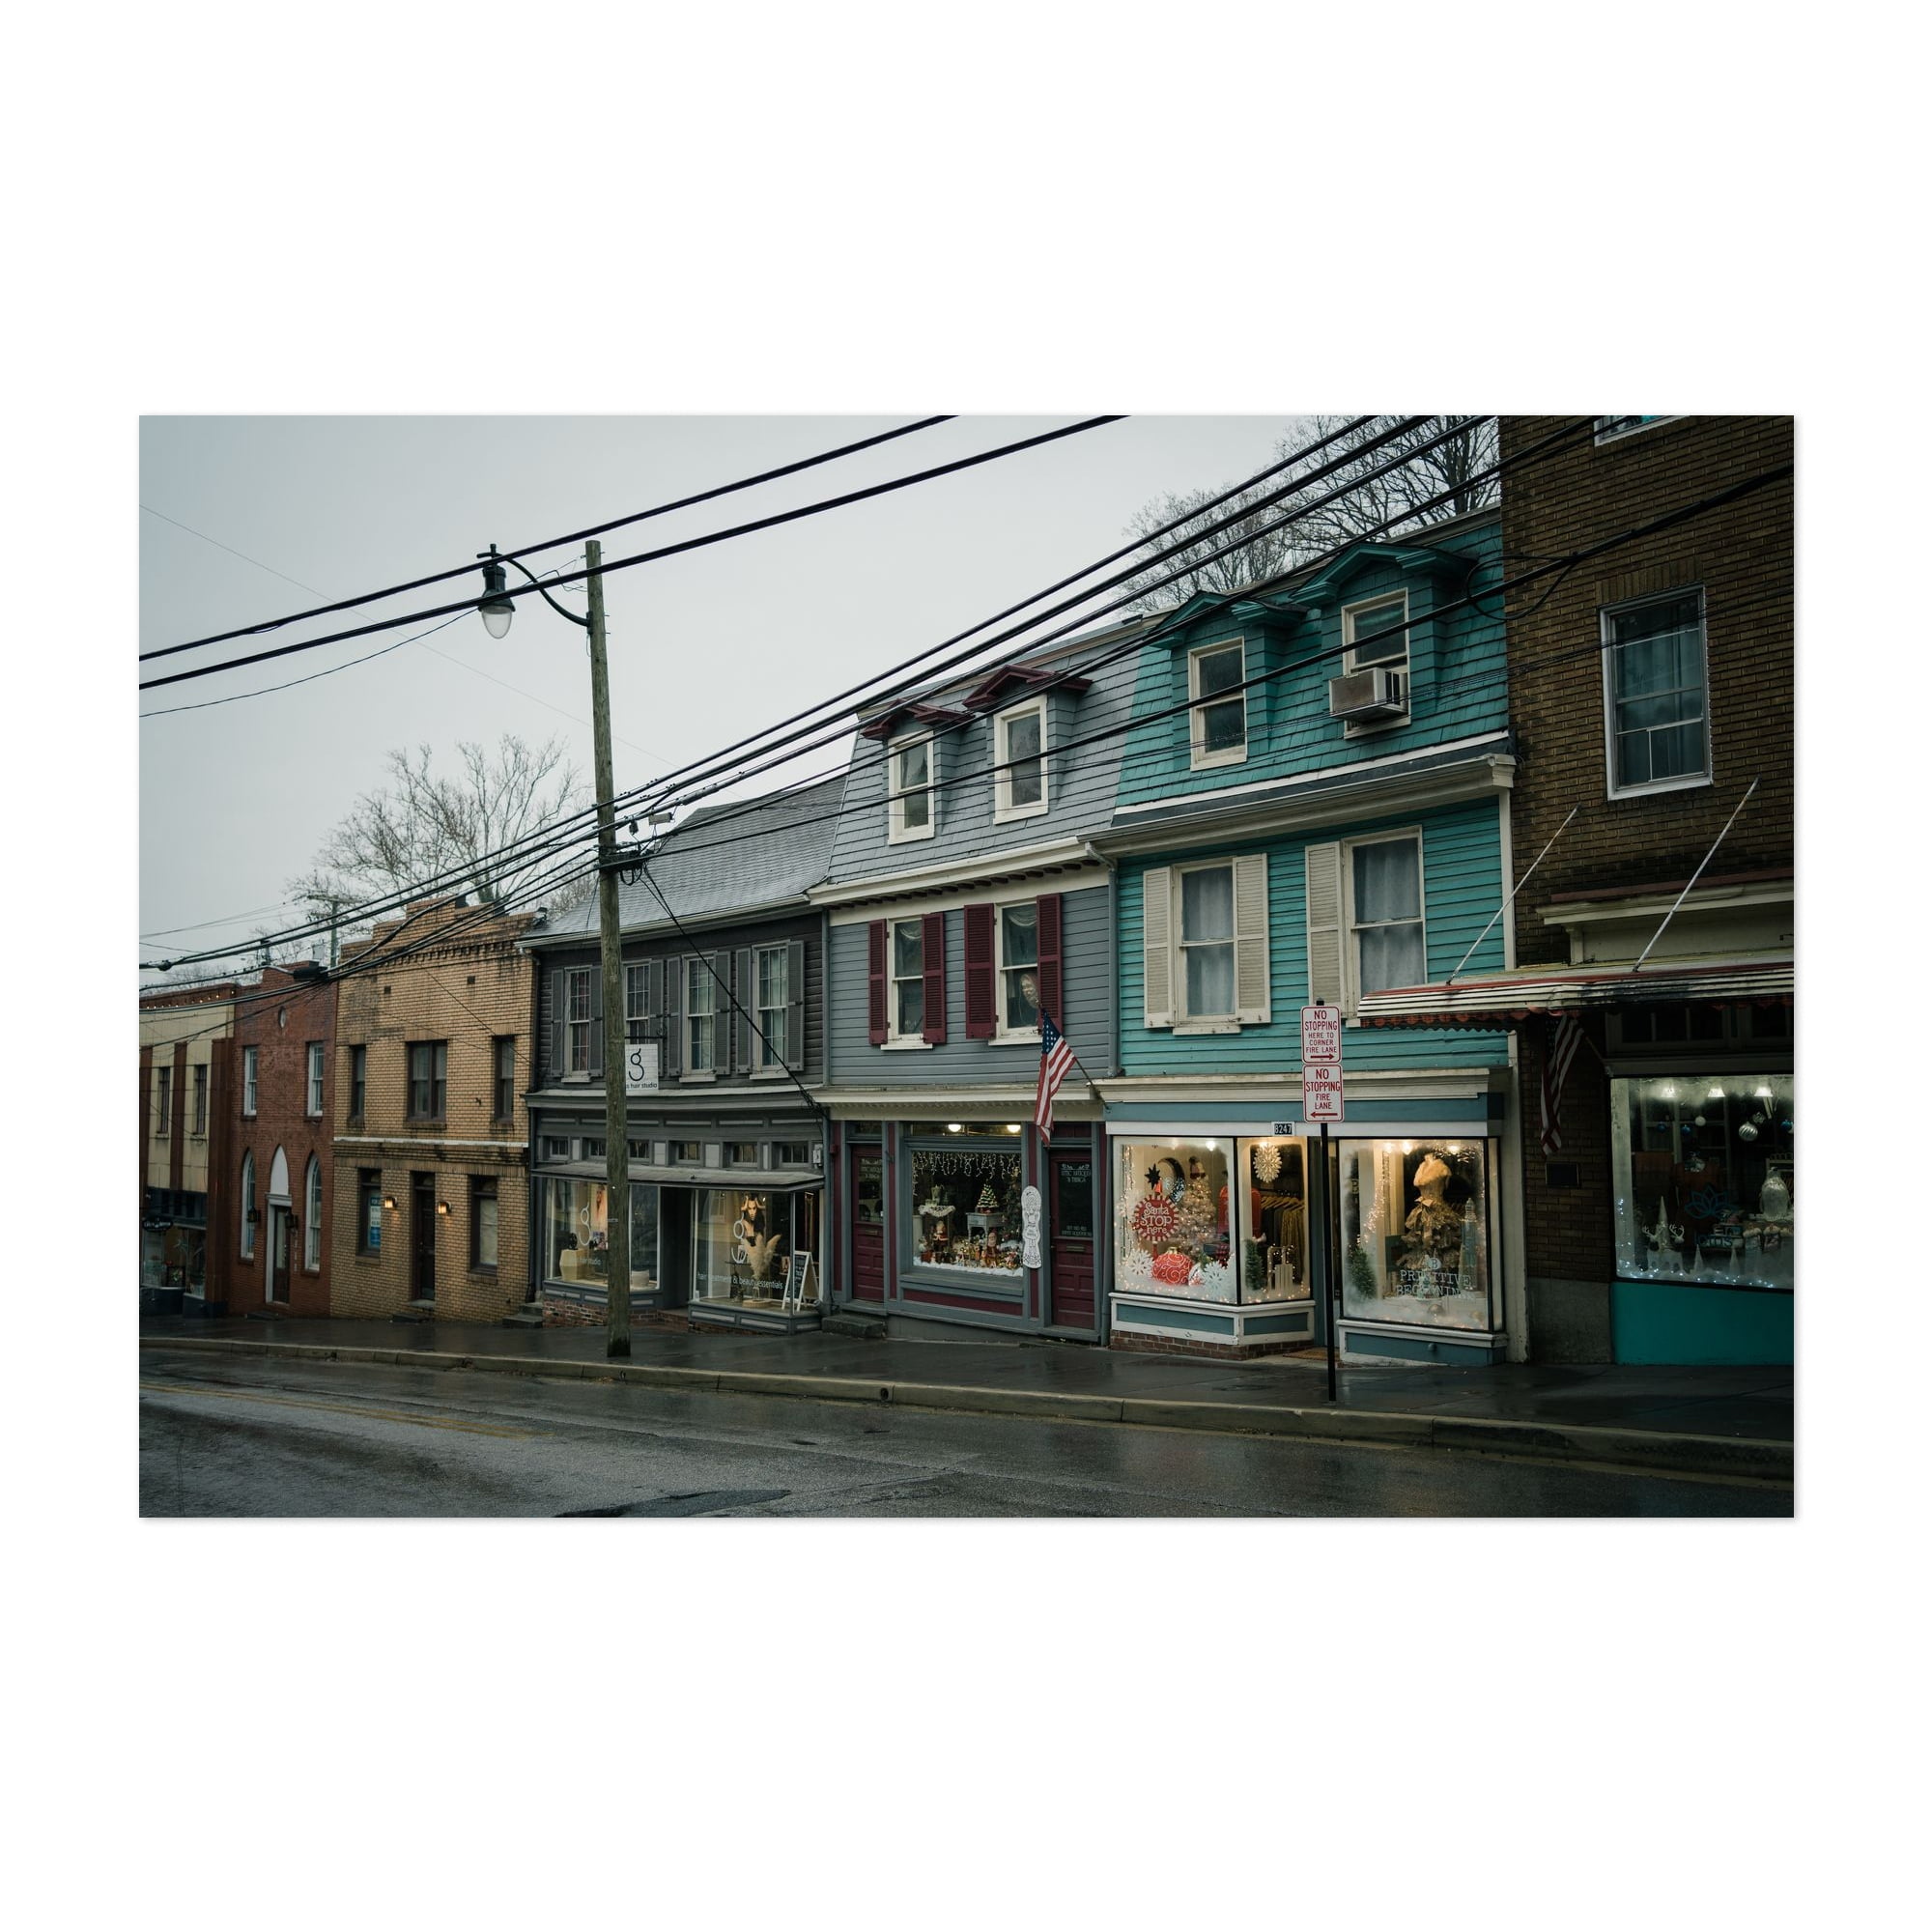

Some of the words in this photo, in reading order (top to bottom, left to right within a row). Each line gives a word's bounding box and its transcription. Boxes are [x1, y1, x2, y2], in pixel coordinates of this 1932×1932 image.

[1314, 1009, 1327, 1020] NO
[1304, 1021, 1338, 1031] STOPPING
[1316, 1068, 1329, 1080] NO
[1305, 1081, 1341, 1093] STOPPING
[1315, 1101, 1332, 1110] LANE
[1274, 1123, 1292, 1134] 8247
[1144, 1202, 1170, 1216] Santa
[1139, 1215, 1173, 1227] STOP
[1146, 1225, 1168, 1236] here
